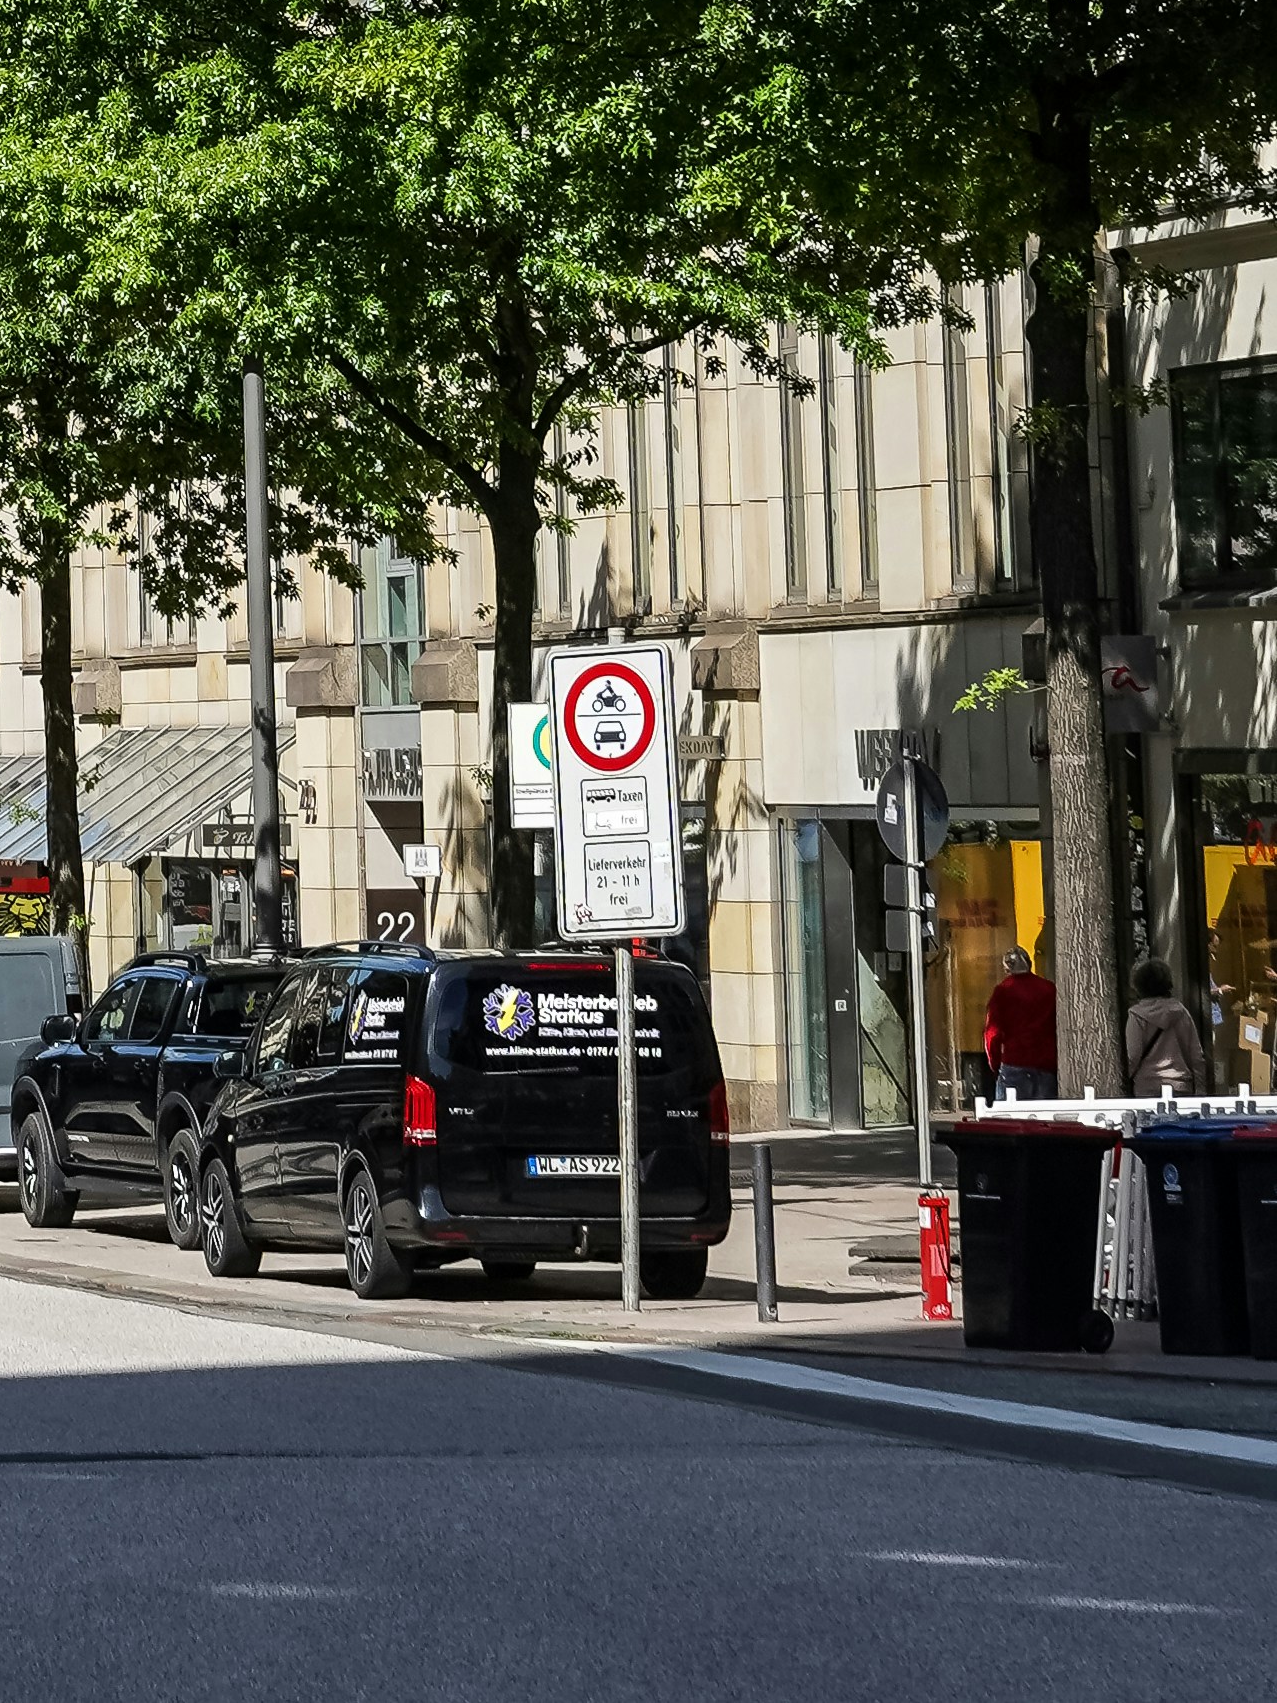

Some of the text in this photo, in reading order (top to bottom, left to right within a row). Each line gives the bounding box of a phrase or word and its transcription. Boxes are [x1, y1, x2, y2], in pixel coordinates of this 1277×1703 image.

[679, 740, 715, 755] EKDAY
[617, 789, 644, 803] Taxen
[621, 812, 638, 826] frei
[587, 854, 647, 872] Lieferverkehr
[596, 875, 609, 889] 21
[622, 875, 631, 888] 11
[634, 874, 640, 886] h
[609, 892, 629, 906] frei
[377, 911, 416, 943] 22
[537, 993, 658, 1012] Meisterbeieb
[538, 1008, 604, 1024] Statkus
[536, 1157, 559, 1173] WL
[569, 1157, 589, 1173] AS
